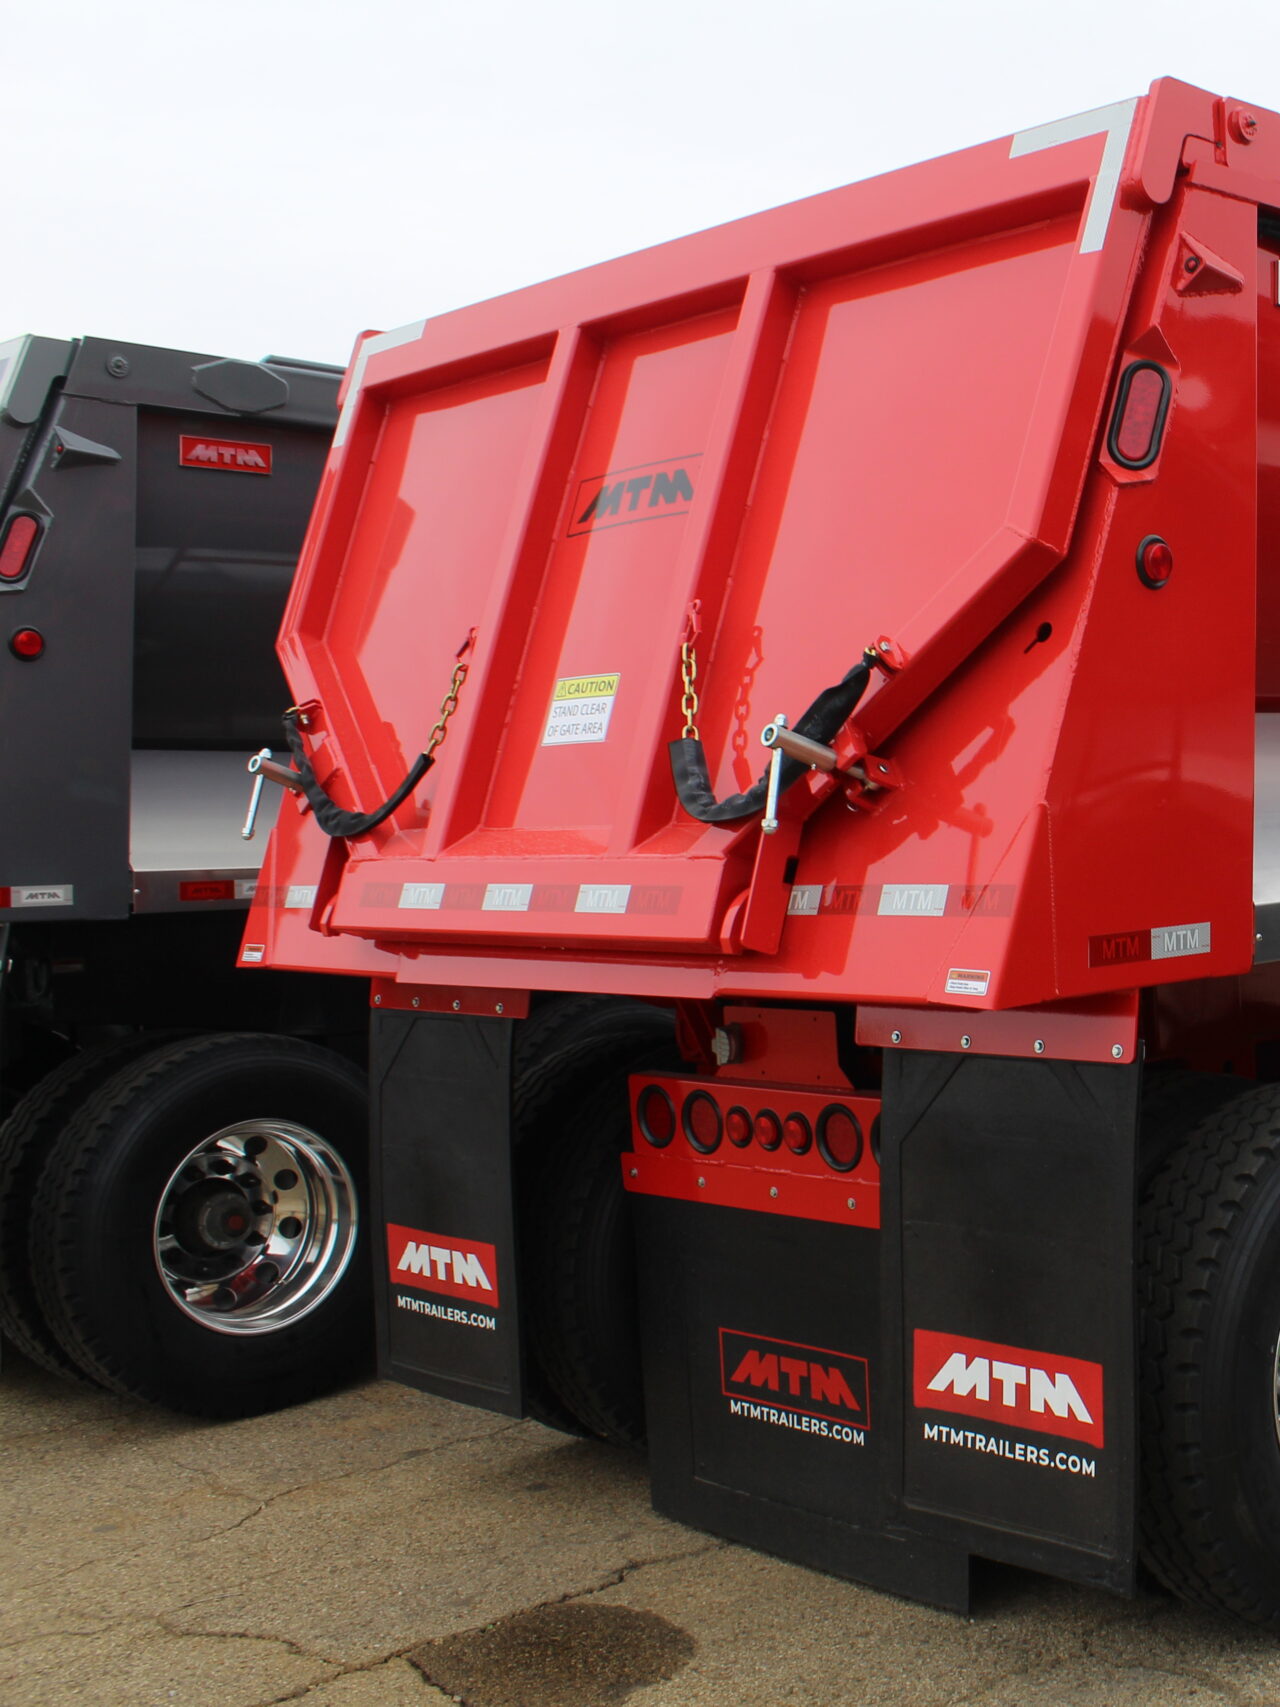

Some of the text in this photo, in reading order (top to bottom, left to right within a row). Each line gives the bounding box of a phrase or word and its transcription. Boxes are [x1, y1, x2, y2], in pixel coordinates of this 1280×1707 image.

[185, 444, 267, 468] MTM
[576, 468, 694, 524] MTM
[567, 680, 615, 695] CAUTION
[552, 702, 607, 718] STAND CLEAR
[547, 721, 603, 737] OF GATE AREA
[24, 892, 61, 901] MTM
[409, 888, 436, 905] MTM
[492, 889, 522, 906] MTM
[586, 890, 618, 908] MTM
[893, 891, 934, 911] MTM
[1102, 935, 1140, 960] MTM
[1164, 929, 1200, 952] MTM
[397, 1241, 493, 1291] MTM
[397, 1295, 496, 1331] MTMTRAILERS.COM
[730, 1349, 861, 1412] MTM
[926, 1352, 1094, 1425] MTM
[730, 1399, 865, 1447] MTMTRAILERS.COM
[923, 1422, 1096, 1478] MTMTRAILERS.COM
